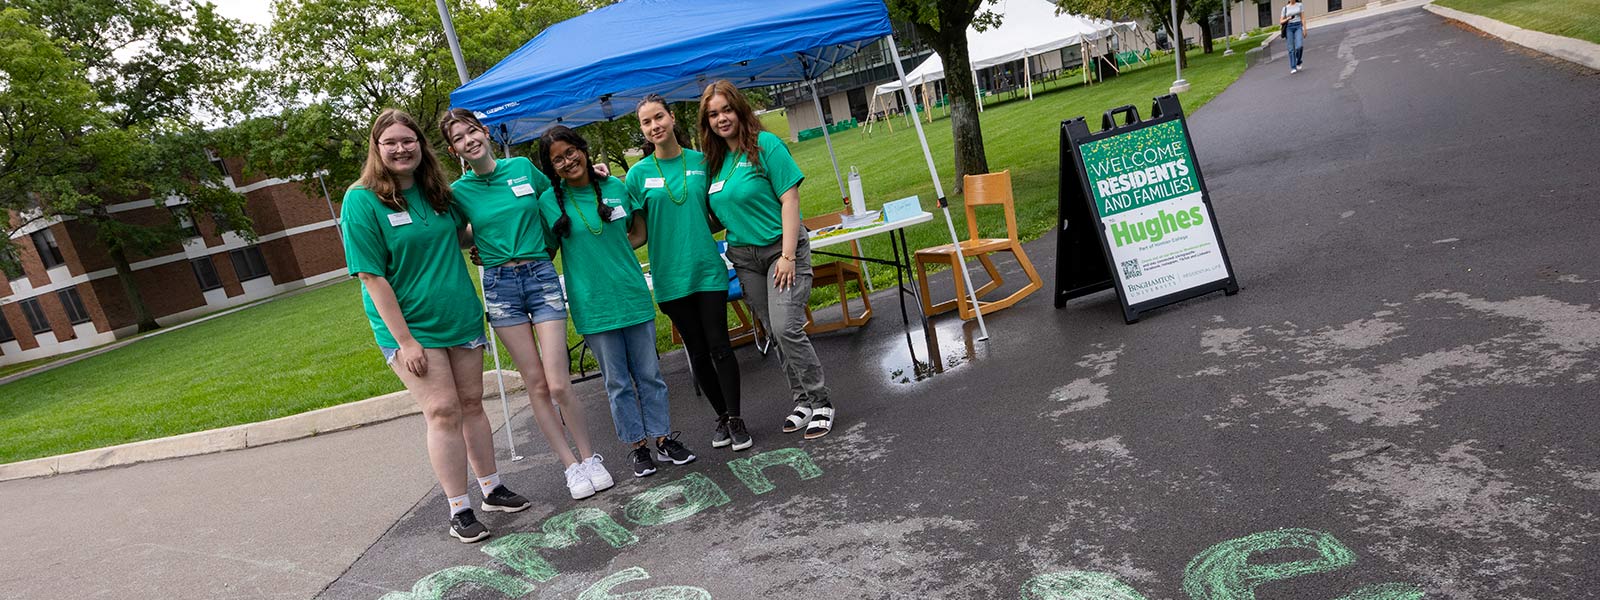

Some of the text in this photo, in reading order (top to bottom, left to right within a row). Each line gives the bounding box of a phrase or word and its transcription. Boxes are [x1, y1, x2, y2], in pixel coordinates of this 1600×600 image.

[1090, 141, 1185, 177] WELCOME
[1096, 158, 1189, 198] RESIDENTS
[1104, 177, 1192, 214] AND FAMILIES!
[1110, 205, 1204, 248] Hughes
[1128, 274, 1175, 292] BINGHAMTON
